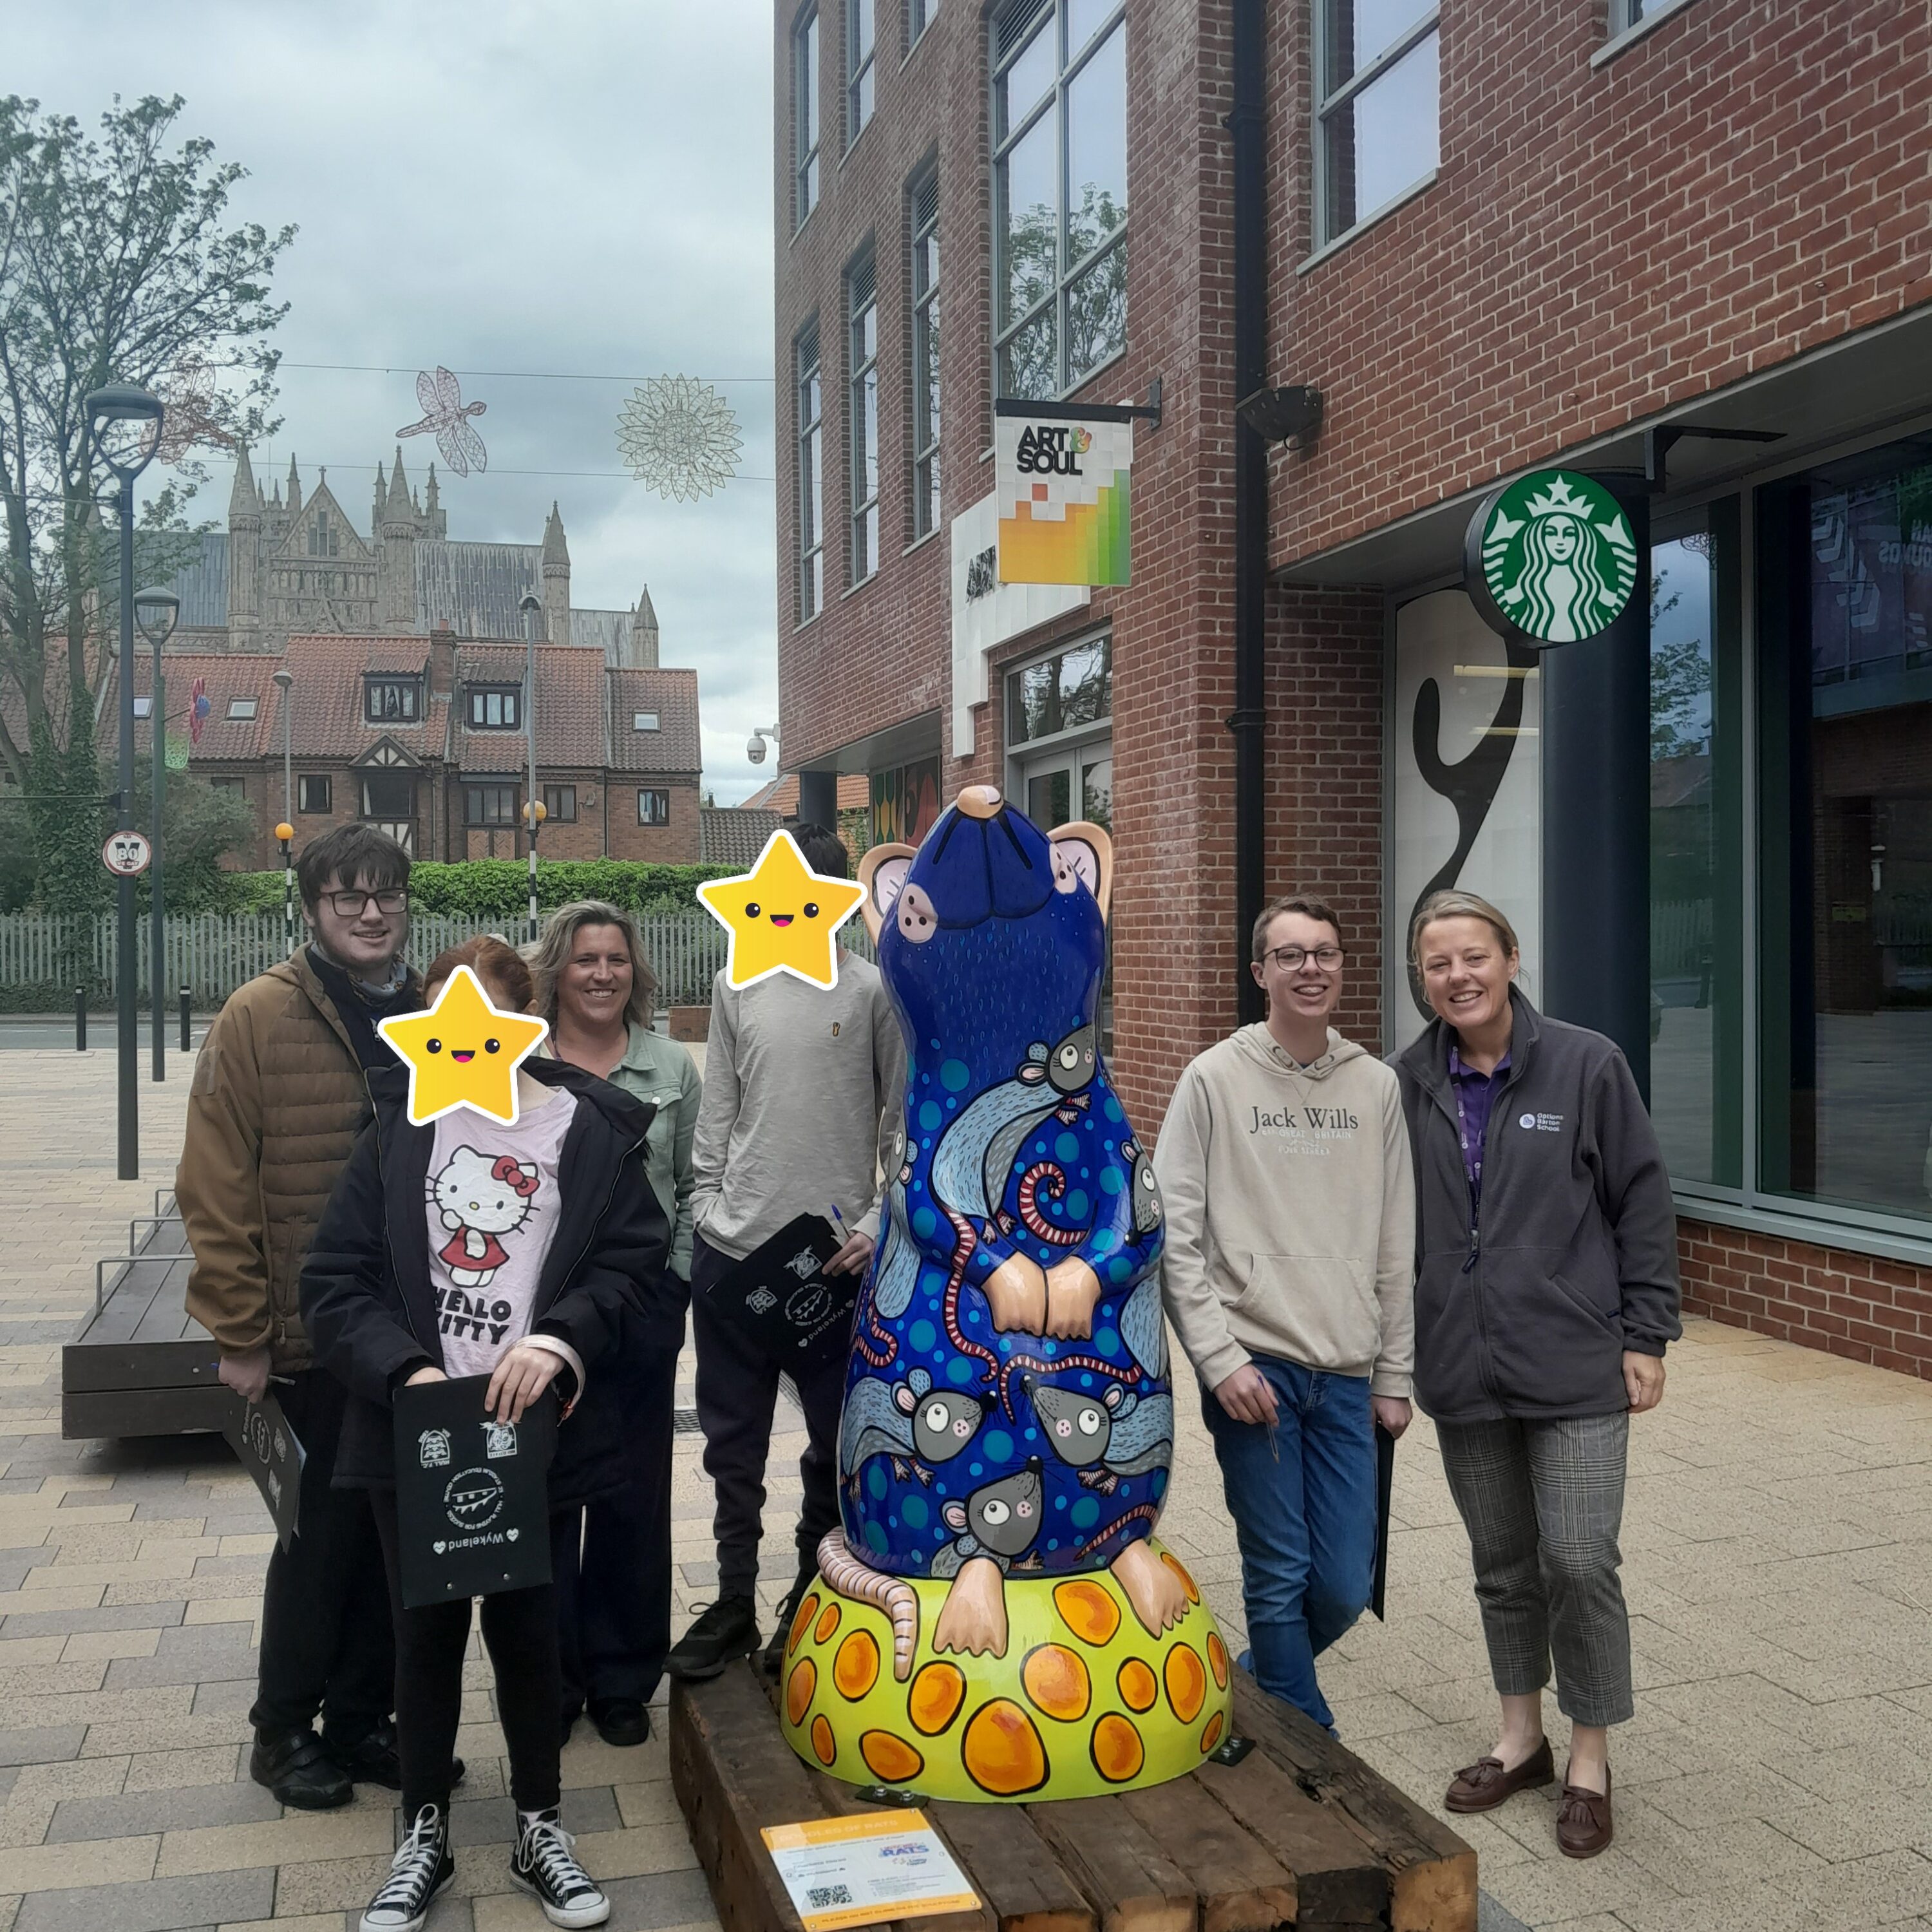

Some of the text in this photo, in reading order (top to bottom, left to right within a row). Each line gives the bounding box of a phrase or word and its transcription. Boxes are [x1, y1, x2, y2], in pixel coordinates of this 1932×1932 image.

[1017, 451, 1083, 475] SOUL
[117, 848, 138, 860] 80
[1250, 1106, 1358, 1133] Jack Wills
[1314, 1130, 1351, 1139] BRITAIN
[437, 1312, 509, 1345] ITTY
[808, 1308, 846, 1340] Wykeland
[435, 1459, 450, 1468] HULL
[451, 1467, 482, 1483] EDUCATION
[464, 1522, 476, 1530] FOR
[448, 1532, 504, 1551] Wykeland
[882, 1844, 930, 1857] RATS
